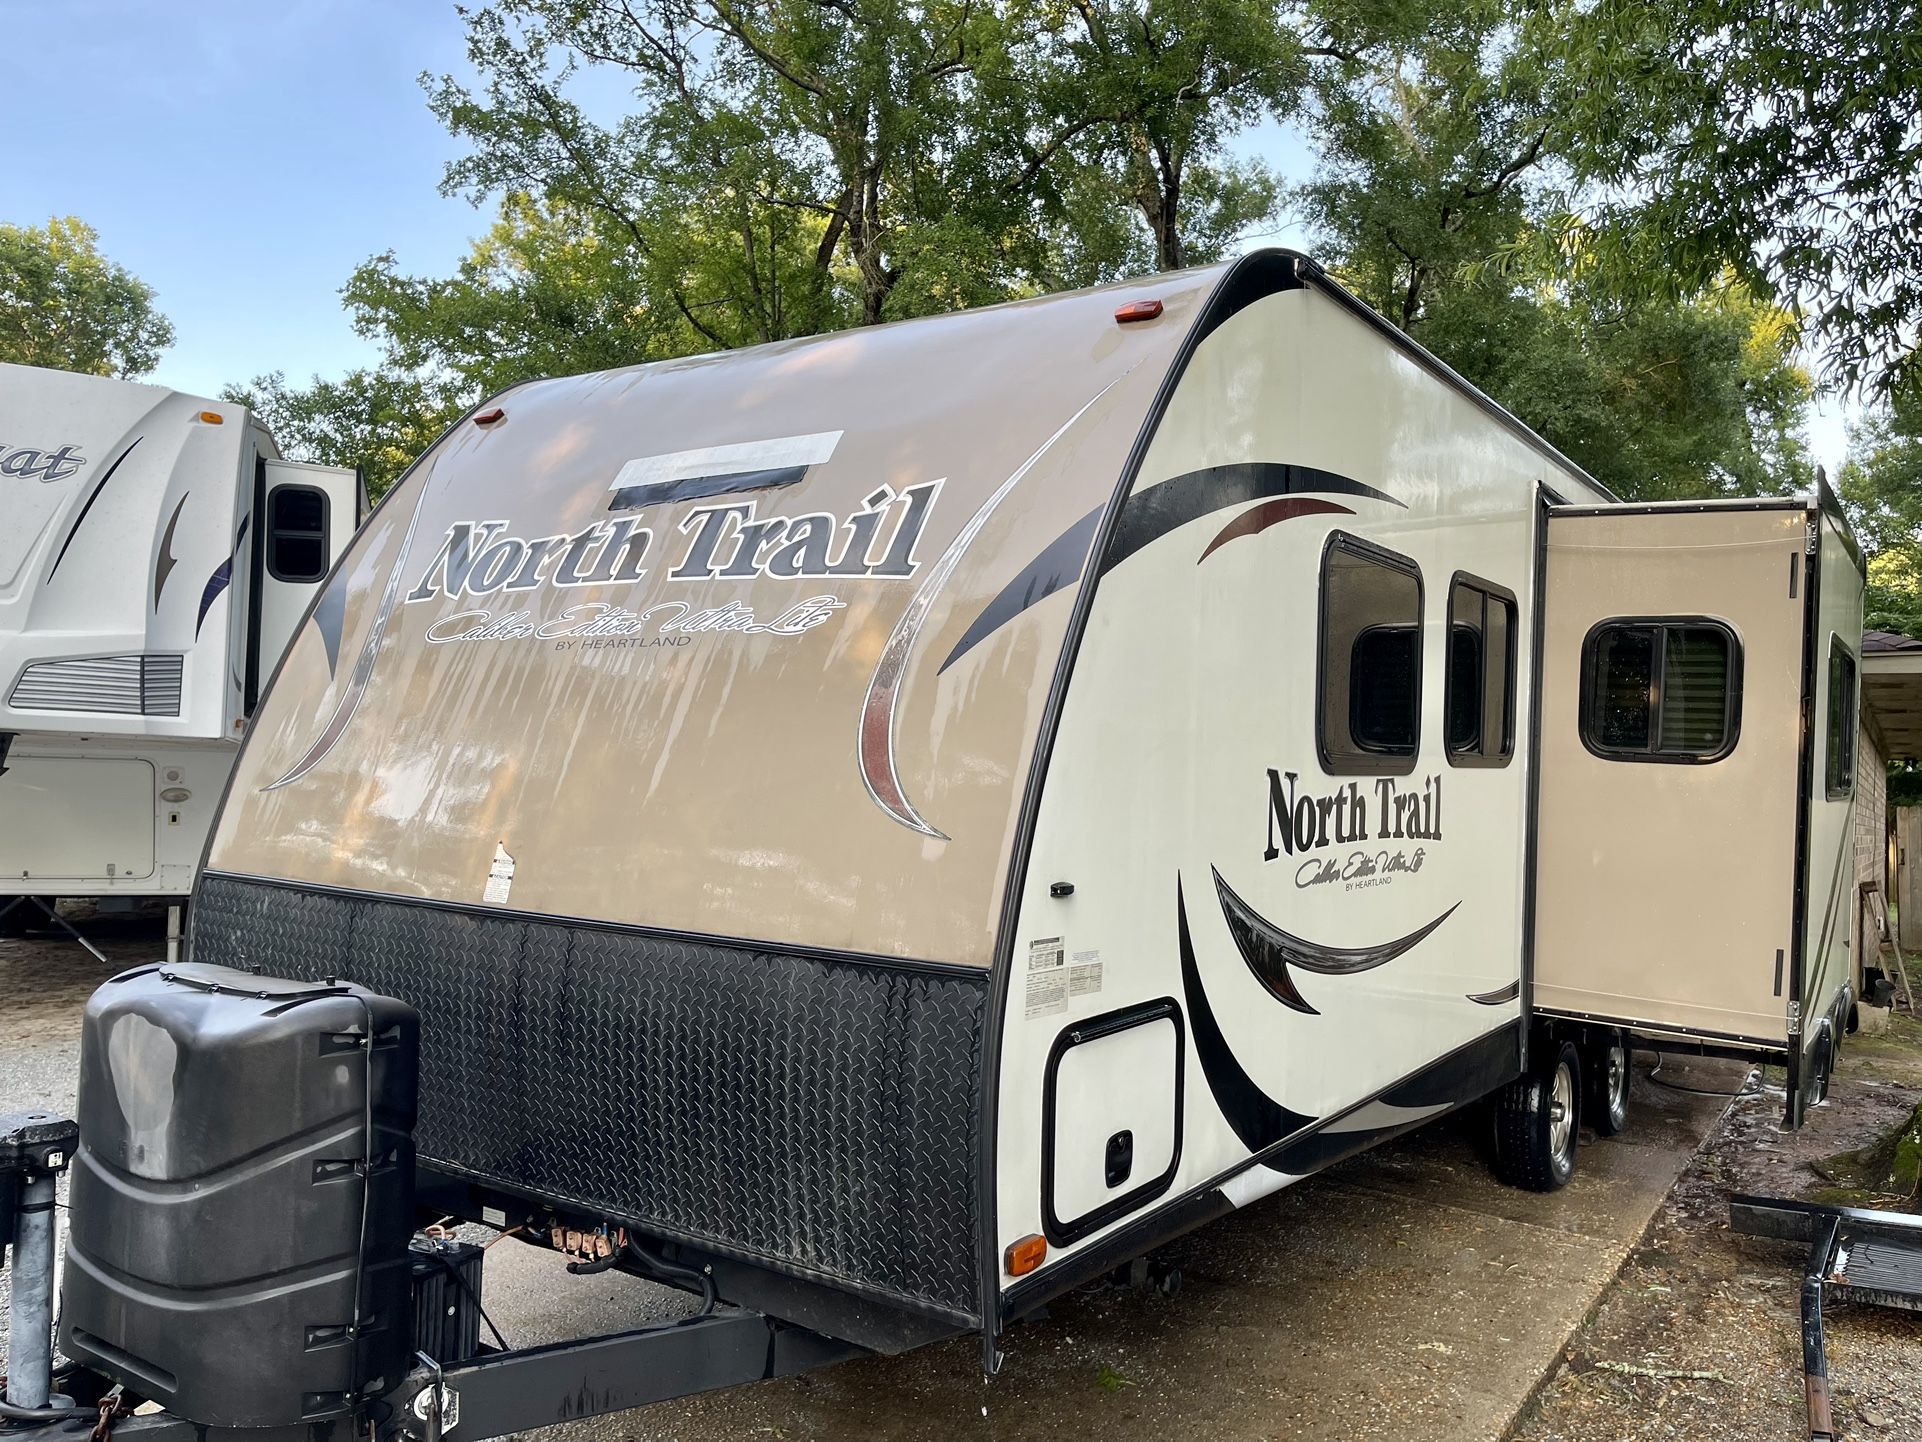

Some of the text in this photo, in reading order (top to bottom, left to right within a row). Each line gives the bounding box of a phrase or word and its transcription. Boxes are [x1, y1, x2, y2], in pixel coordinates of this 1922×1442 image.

[0, 443, 87, 483] at
[404, 477, 948, 604] North Trail
[535, 602, 641, 640] Edition
[555, 635, 692, 651] BY HEARTLAND
[1264, 767, 1443, 862] North Trail
[1345, 876, 1392, 892] BY HEARTLAND
